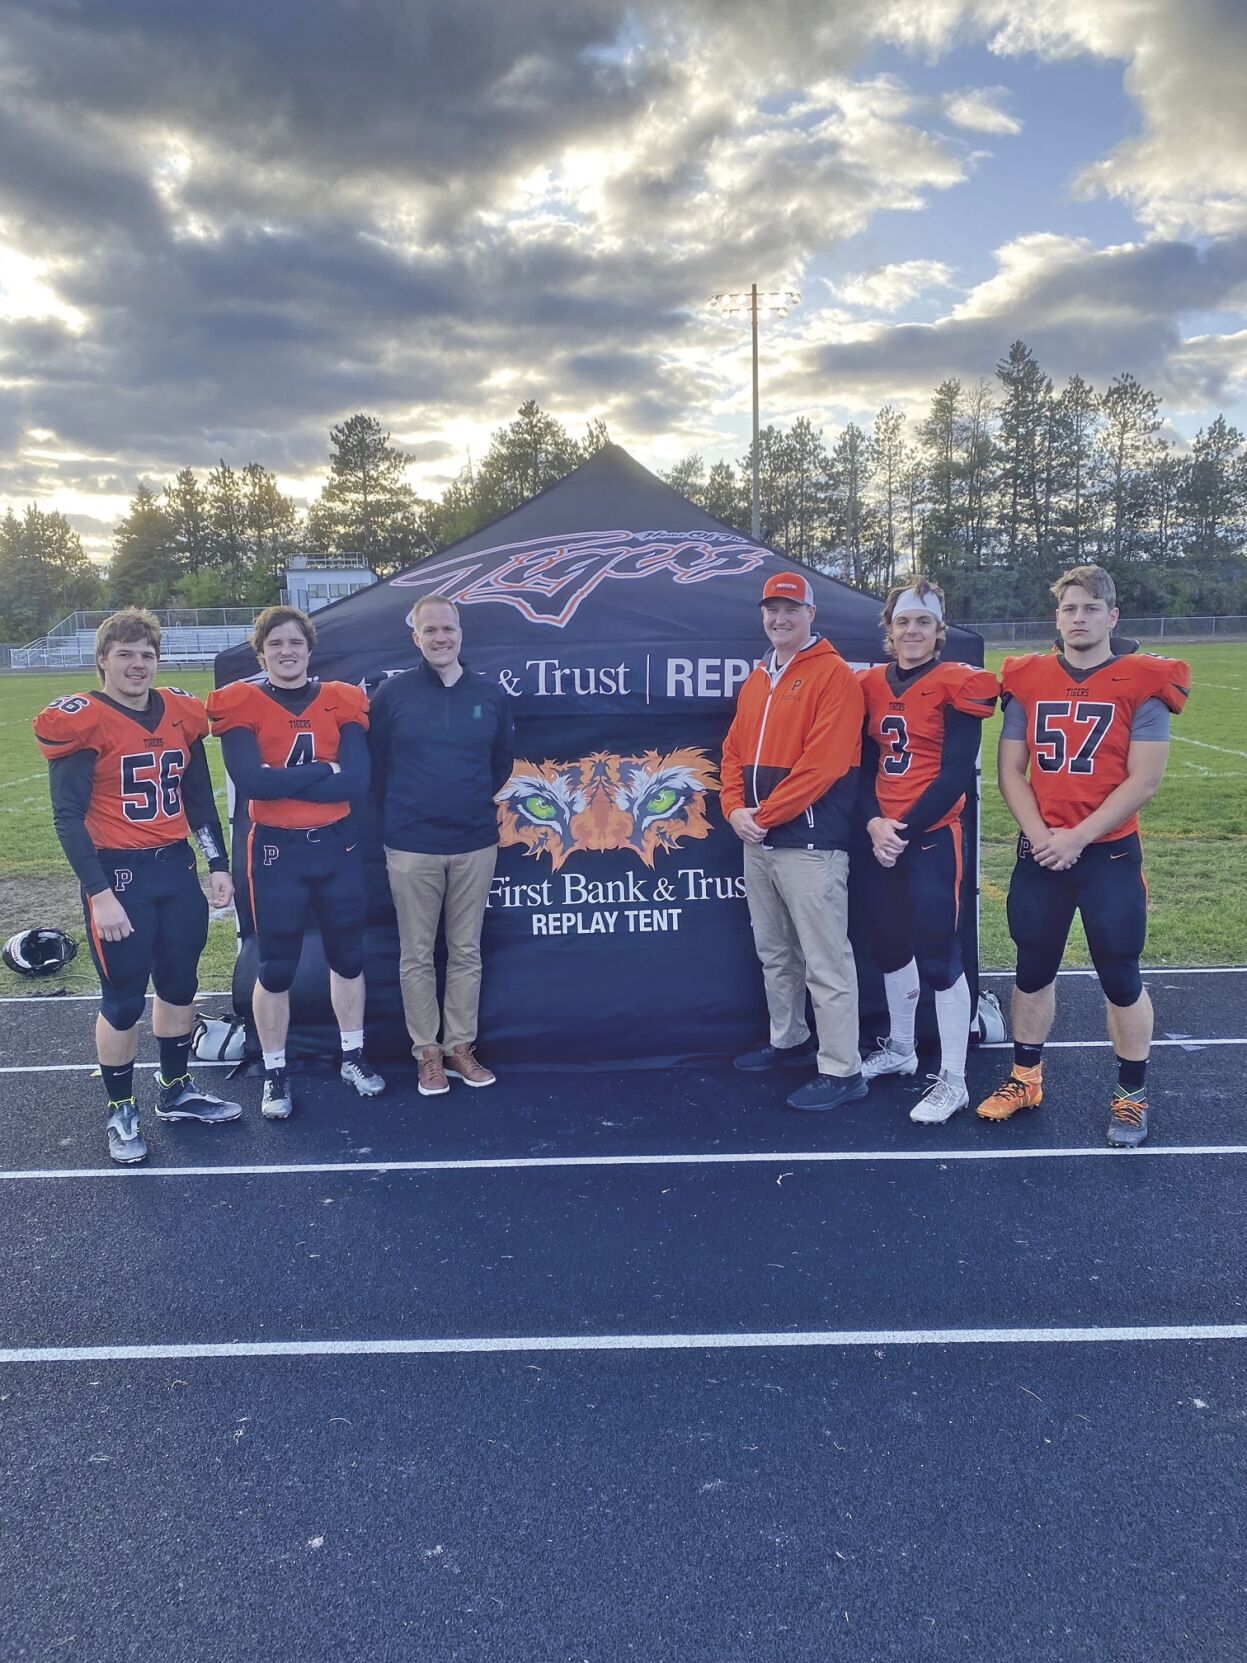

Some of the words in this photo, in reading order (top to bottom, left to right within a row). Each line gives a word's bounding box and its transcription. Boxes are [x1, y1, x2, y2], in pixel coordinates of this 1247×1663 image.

[499, 668, 523, 697] &
[525, 659, 631, 697] Trust
[666, 657, 763, 698] REP
[1066, 688, 1090, 697] TIGERS
[284, 732, 318, 768] 4
[880, 715, 913, 776] 3
[1034, 700, 1116, 775] 57
[120, 749, 185, 823] 56
[263, 845, 279, 866] P
[114, 869, 133, 892] P
[485, 875, 554, 908] First
[561, 870, 650, 905] Bank
[652, 877, 677, 902] &
[678, 868, 748, 900] Trus
[532, 911, 619, 936] REPLAY
[624, 908, 683, 933] TENT
